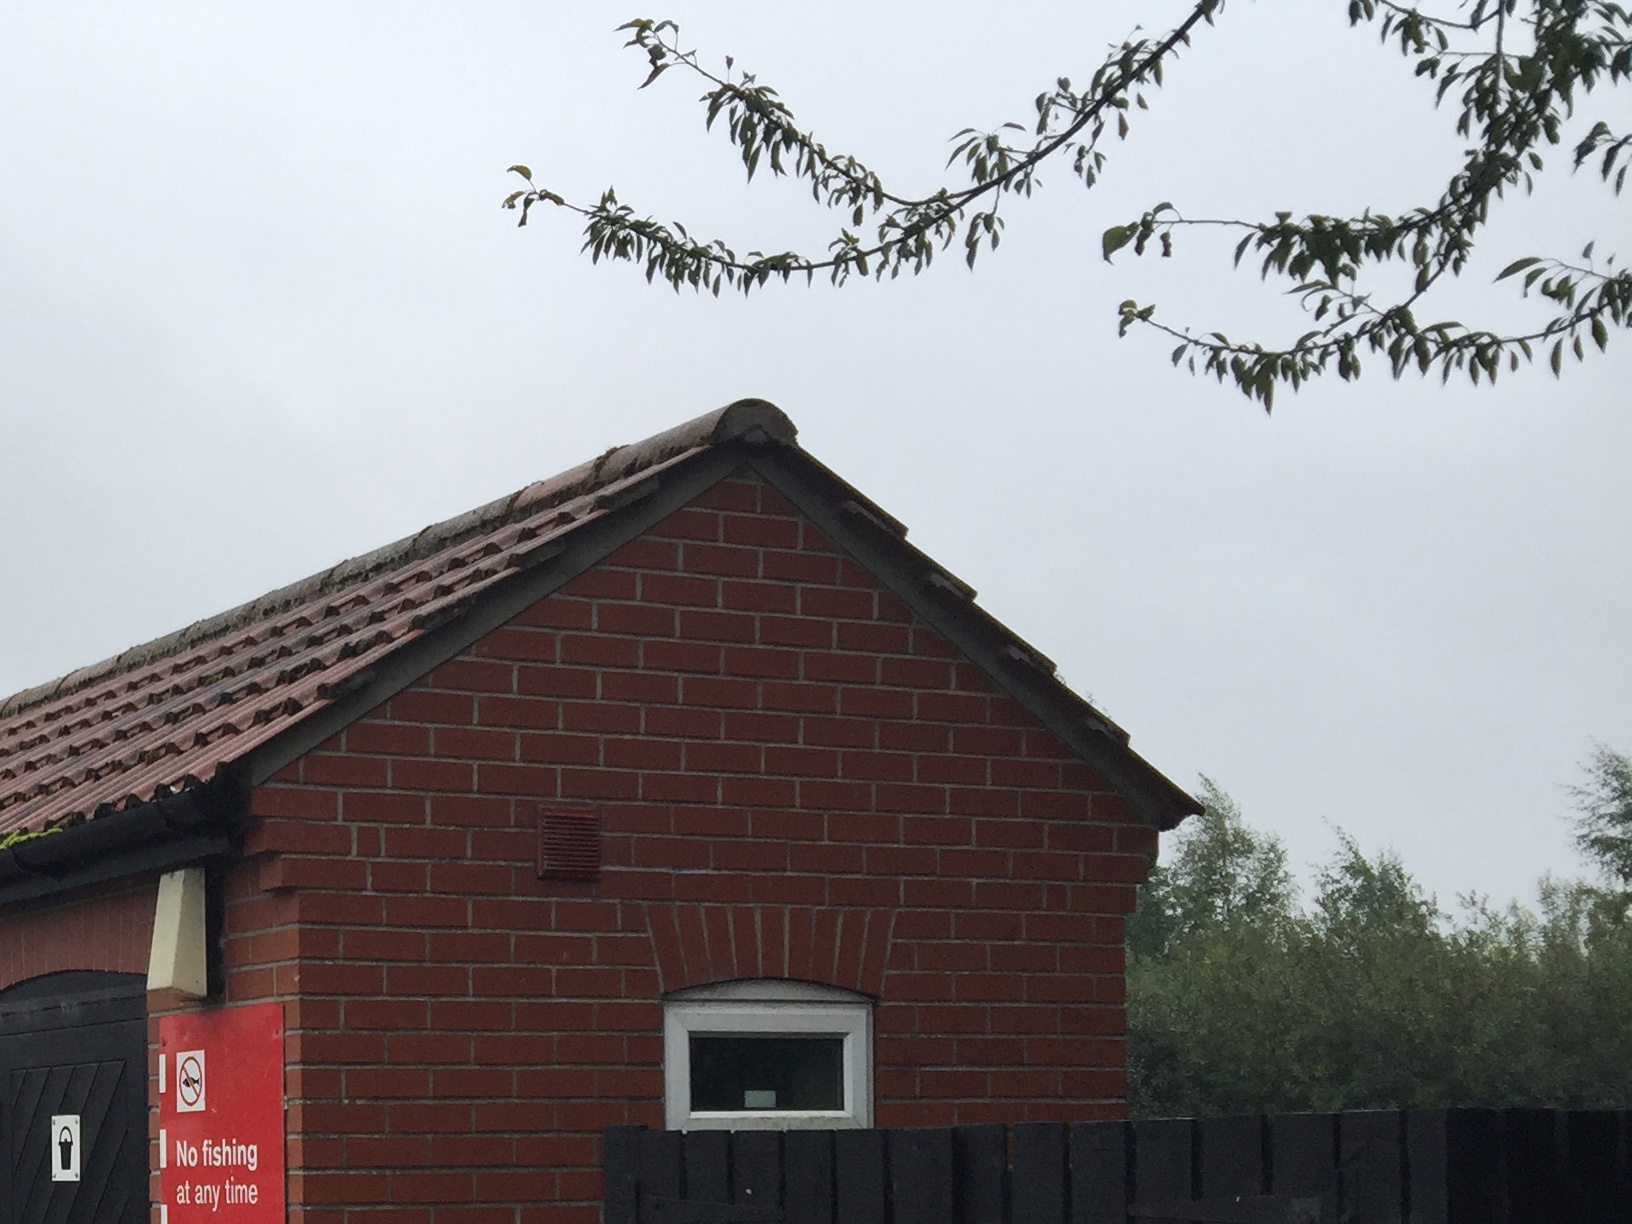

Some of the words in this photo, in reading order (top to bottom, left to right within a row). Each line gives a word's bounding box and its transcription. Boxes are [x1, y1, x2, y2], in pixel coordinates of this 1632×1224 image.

[176, 1140, 198, 1167] No
[202, 1138, 258, 1171] fishing
[176, 1180, 190, 1204] at
[194, 1184, 221, 1212] any
[224, 1176, 258, 1204] time
